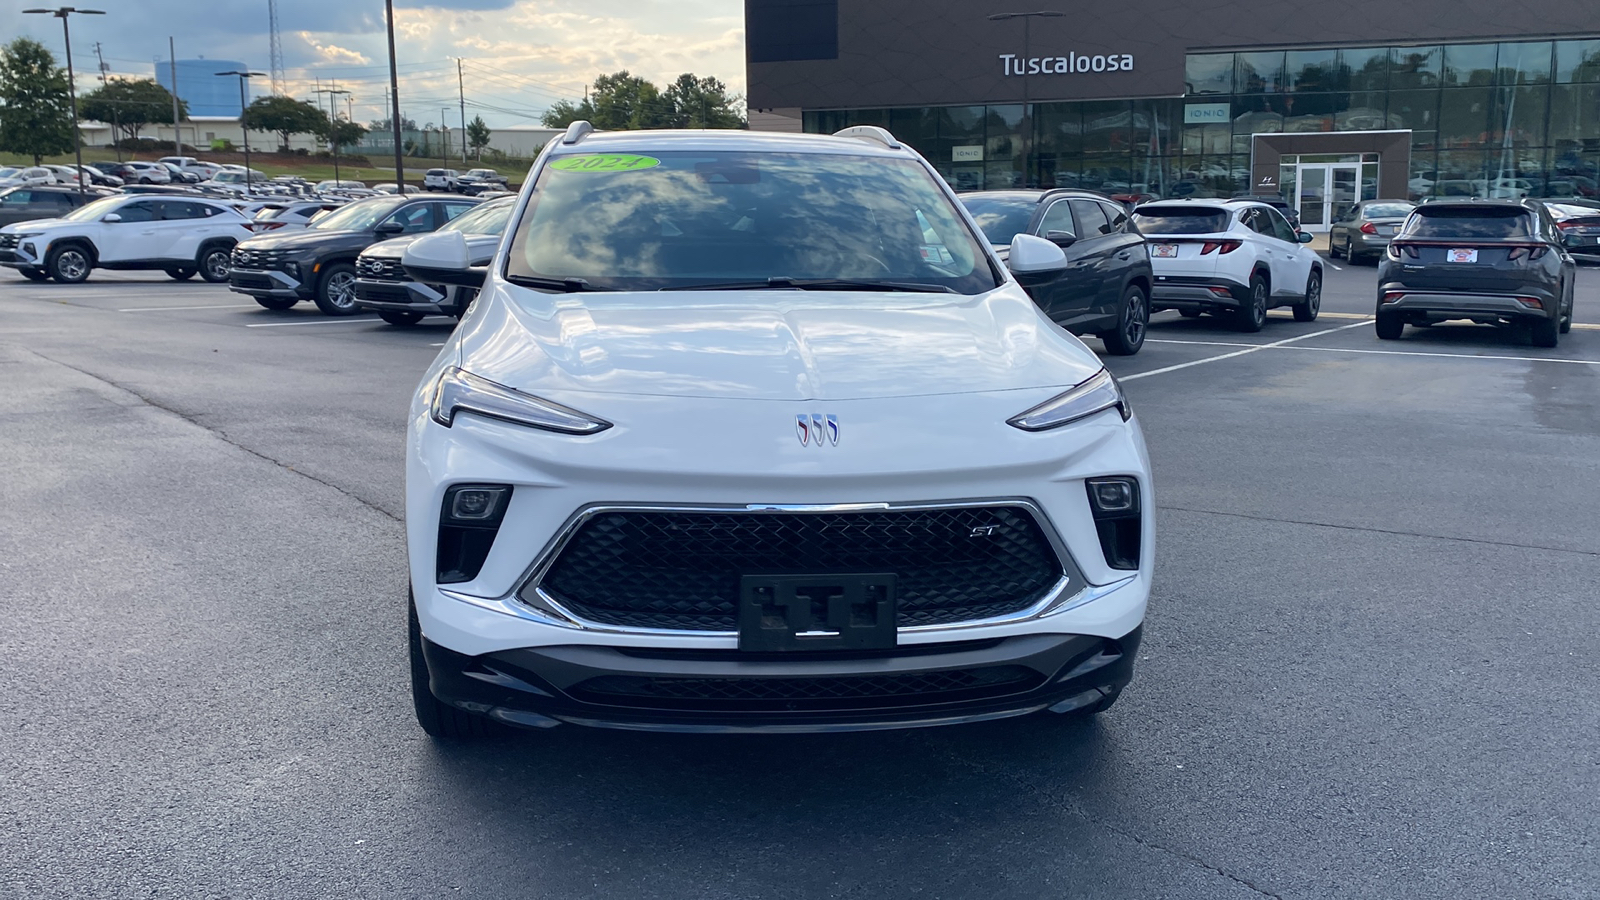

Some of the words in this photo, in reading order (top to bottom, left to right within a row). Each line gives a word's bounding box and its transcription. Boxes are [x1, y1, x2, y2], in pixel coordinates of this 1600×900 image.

[999, 51, 1134, 76] Tuscaloosa
[563, 157, 644, 170] 2024
[969, 524, 1001, 538] ST
